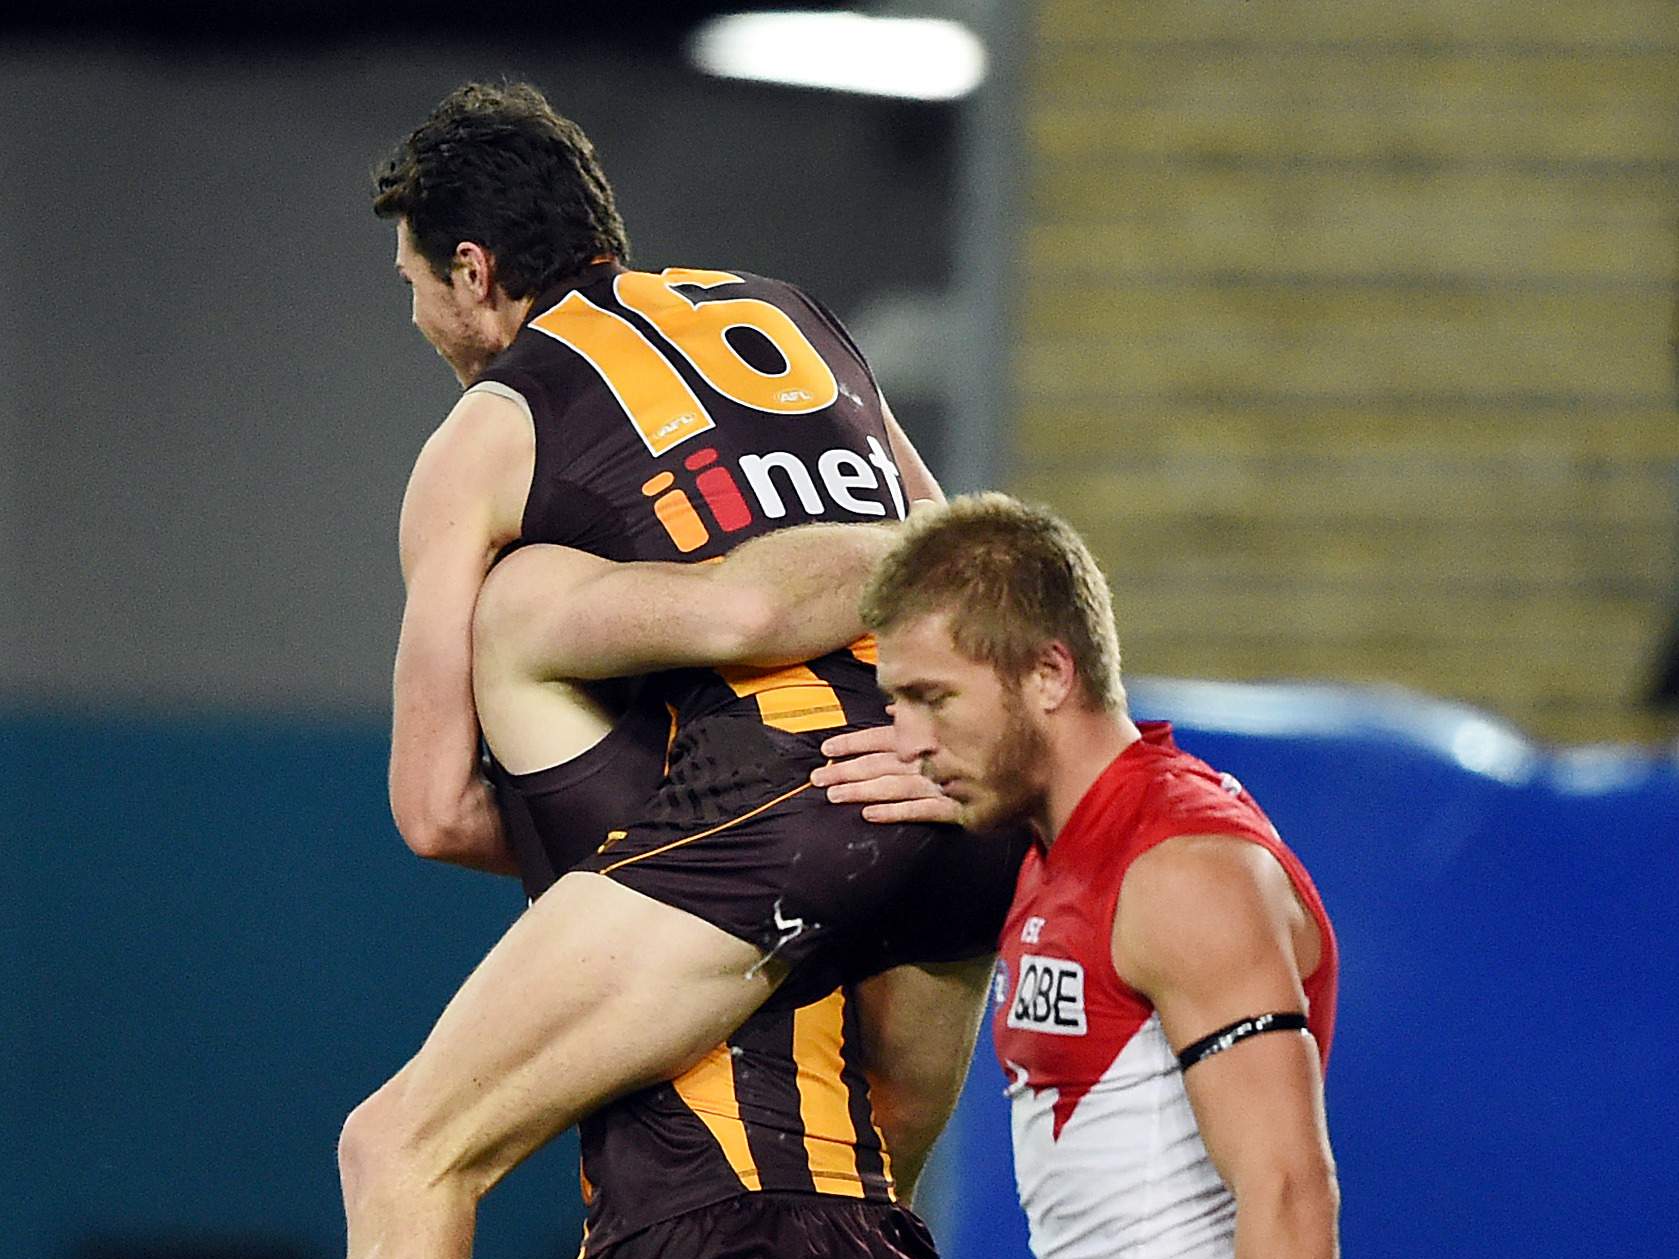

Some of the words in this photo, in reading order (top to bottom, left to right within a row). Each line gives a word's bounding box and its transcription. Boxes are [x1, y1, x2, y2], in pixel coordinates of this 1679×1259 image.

[528, 267, 839, 458] 16
[641, 435, 906, 553] iinet
[1015, 964, 1079, 1026] QBE
